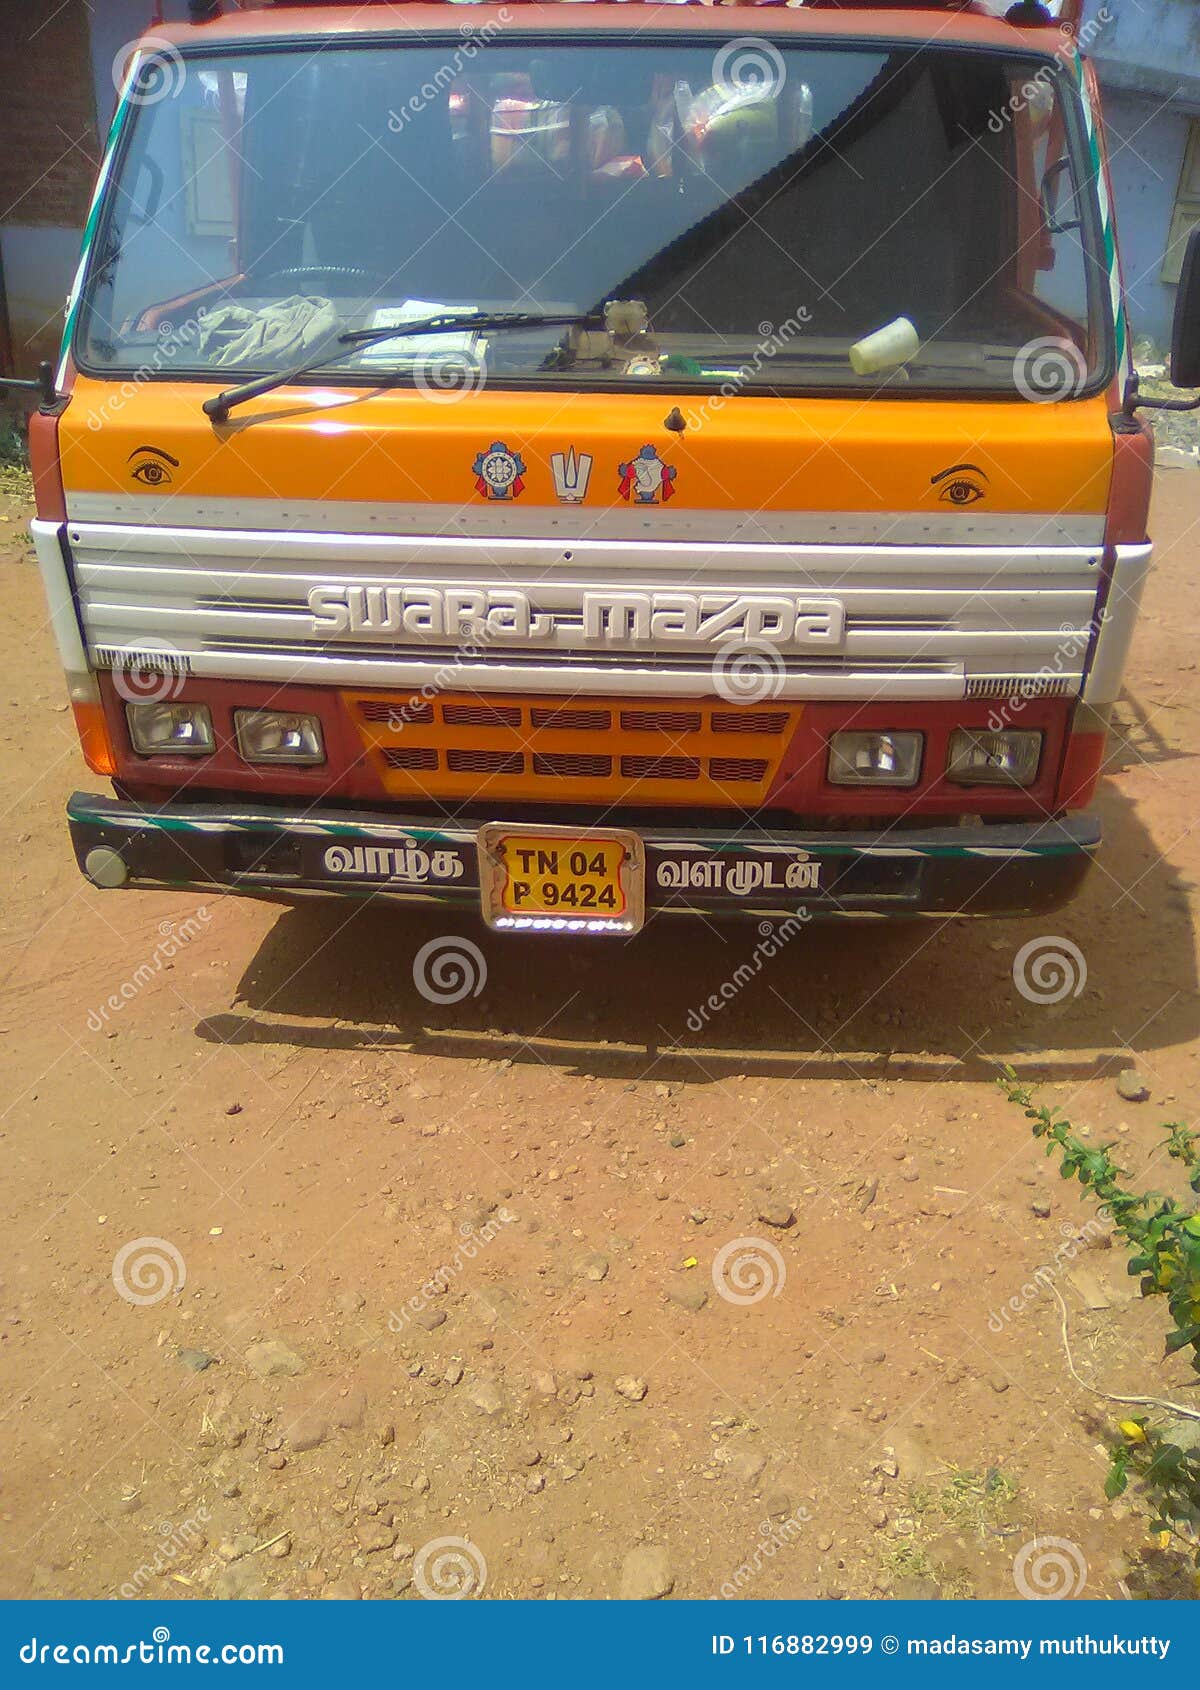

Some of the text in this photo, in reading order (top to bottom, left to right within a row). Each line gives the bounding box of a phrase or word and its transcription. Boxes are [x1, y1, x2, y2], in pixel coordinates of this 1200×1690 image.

[324, 838, 822, 896] வாழ்க வளமுடன்
[516, 849, 607, 877] TN 04
[513, 881, 617, 909] P 9424
